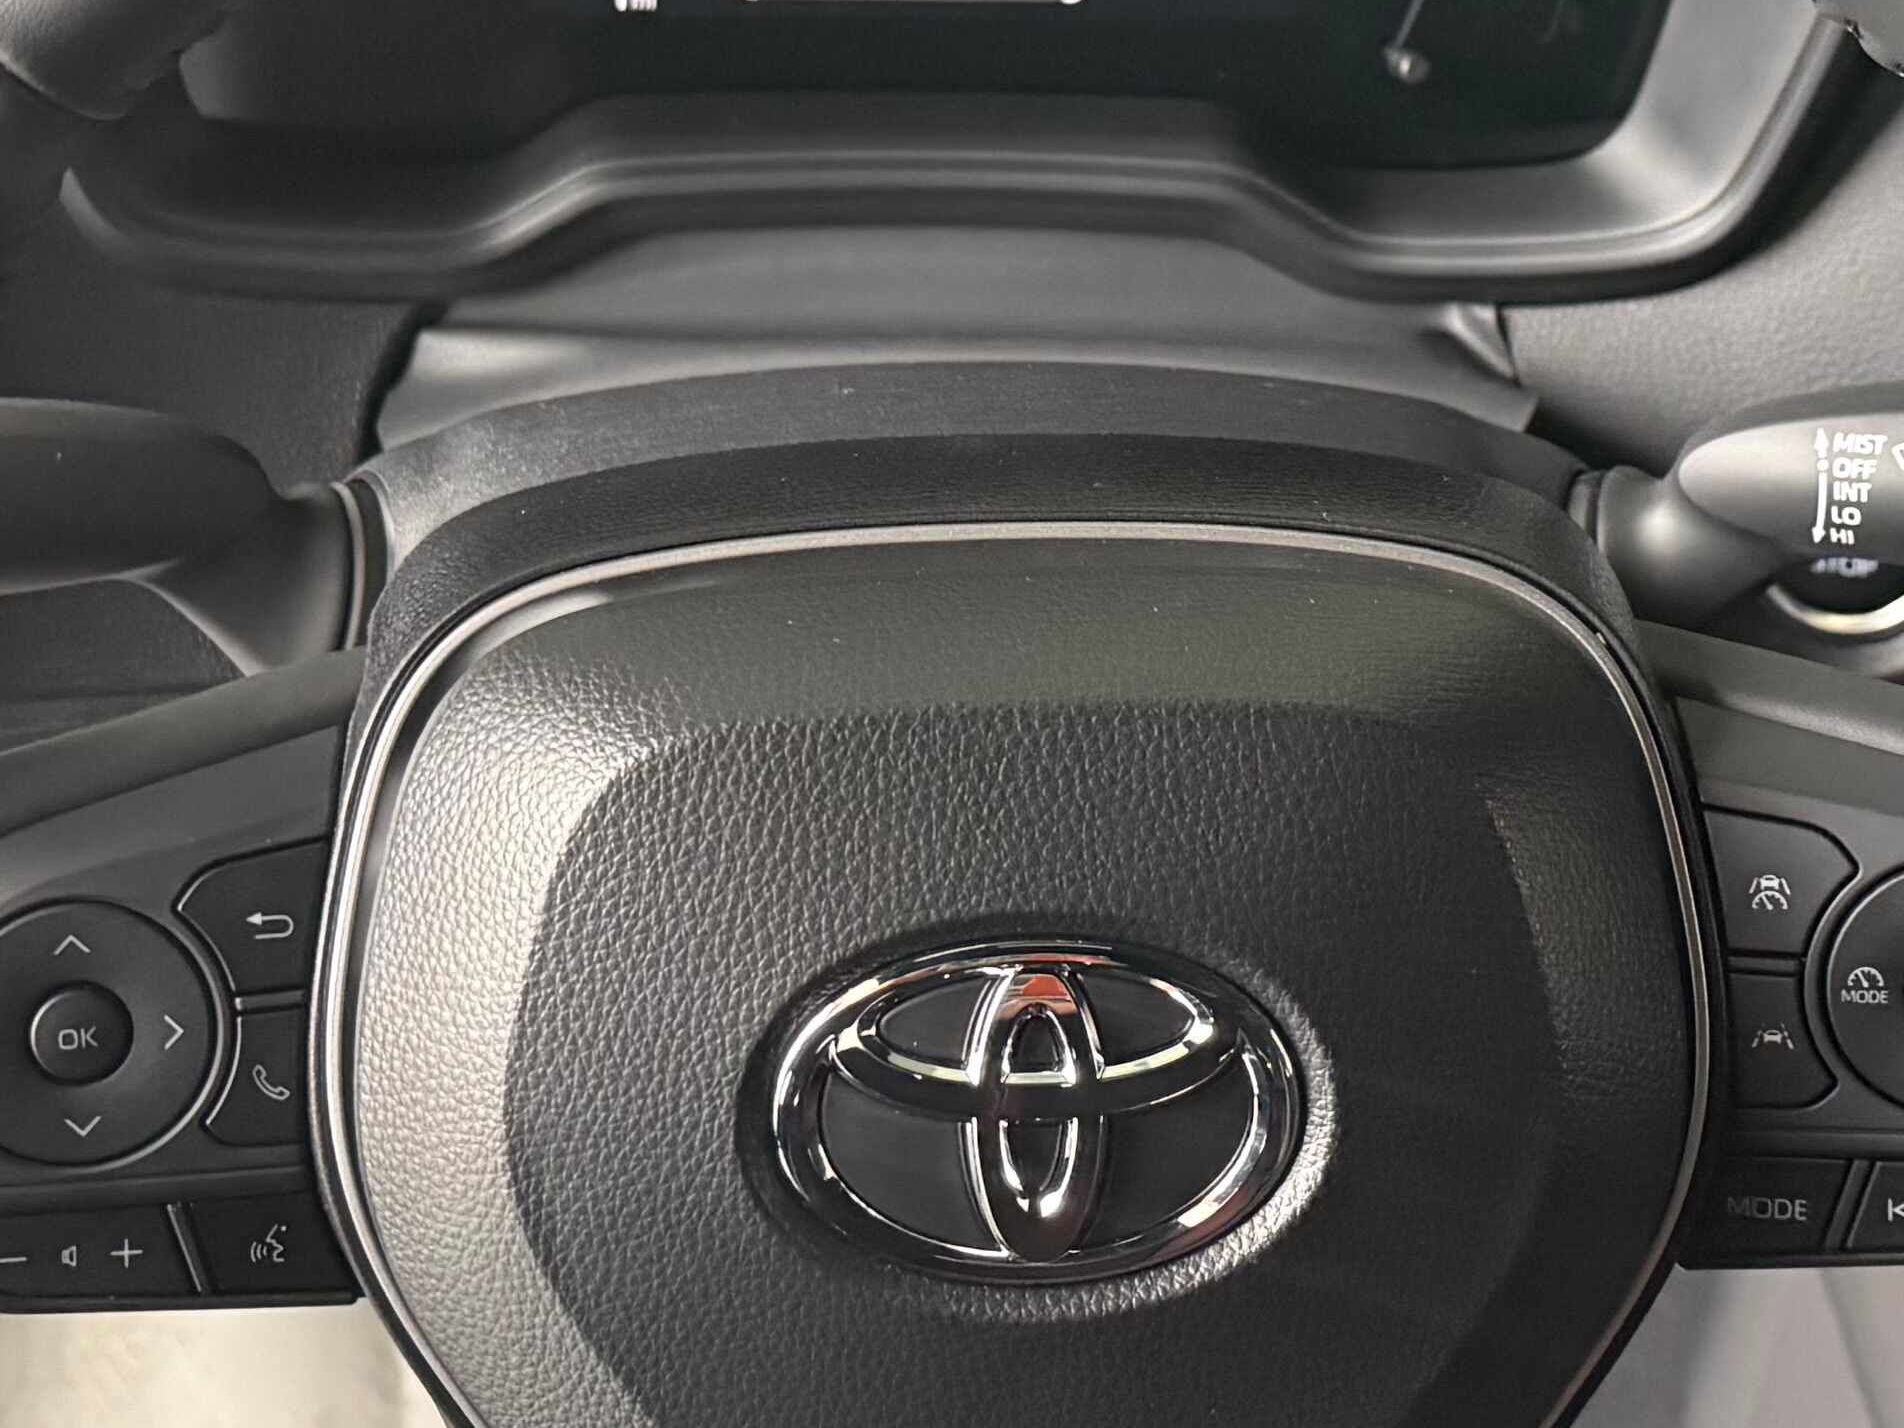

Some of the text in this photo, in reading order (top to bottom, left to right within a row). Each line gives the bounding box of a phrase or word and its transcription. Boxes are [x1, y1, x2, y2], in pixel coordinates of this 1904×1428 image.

[1833, 431, 1888, 455] MIST
[1832, 456, 1878, 480] OFF
[1833, 481, 1873, 504] INT
[1831, 505, 1862, 527] LO
[1829, 527, 1856, 546] HI
[1840, 989, 1889, 1005] MODE
[58, 1025, 99, 1050] OK
[1727, 1195, 1808, 1222] MODE
